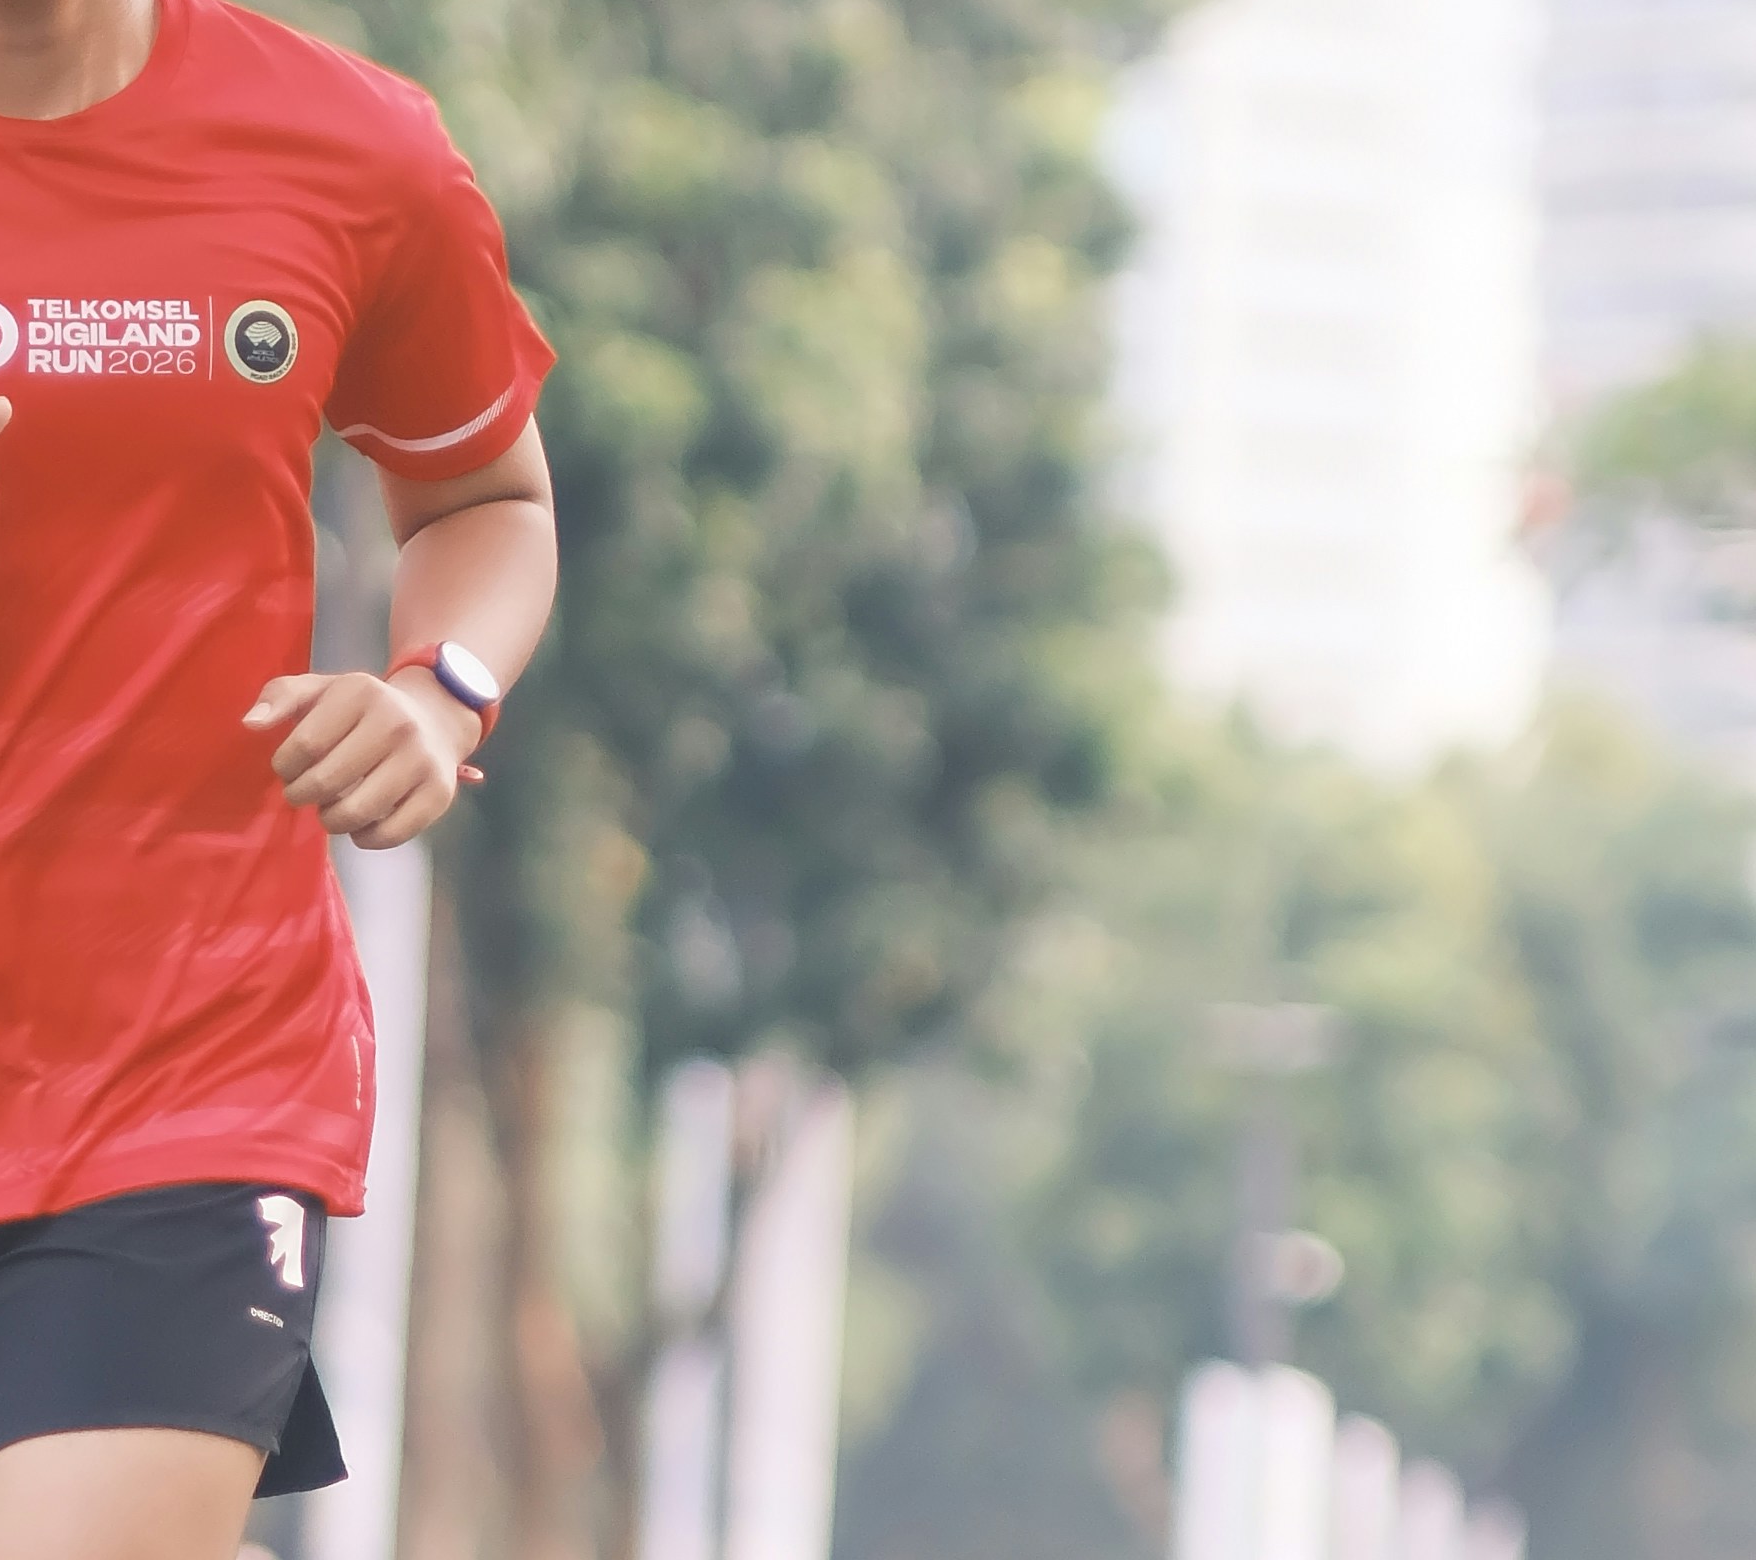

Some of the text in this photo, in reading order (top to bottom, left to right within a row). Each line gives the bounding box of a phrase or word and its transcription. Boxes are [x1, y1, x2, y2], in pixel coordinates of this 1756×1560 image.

[27, 299, 200, 320] TELKOMSEL
[28, 321, 201, 347] DIGILAND
[28, 349, 196, 375] RUN 2026
